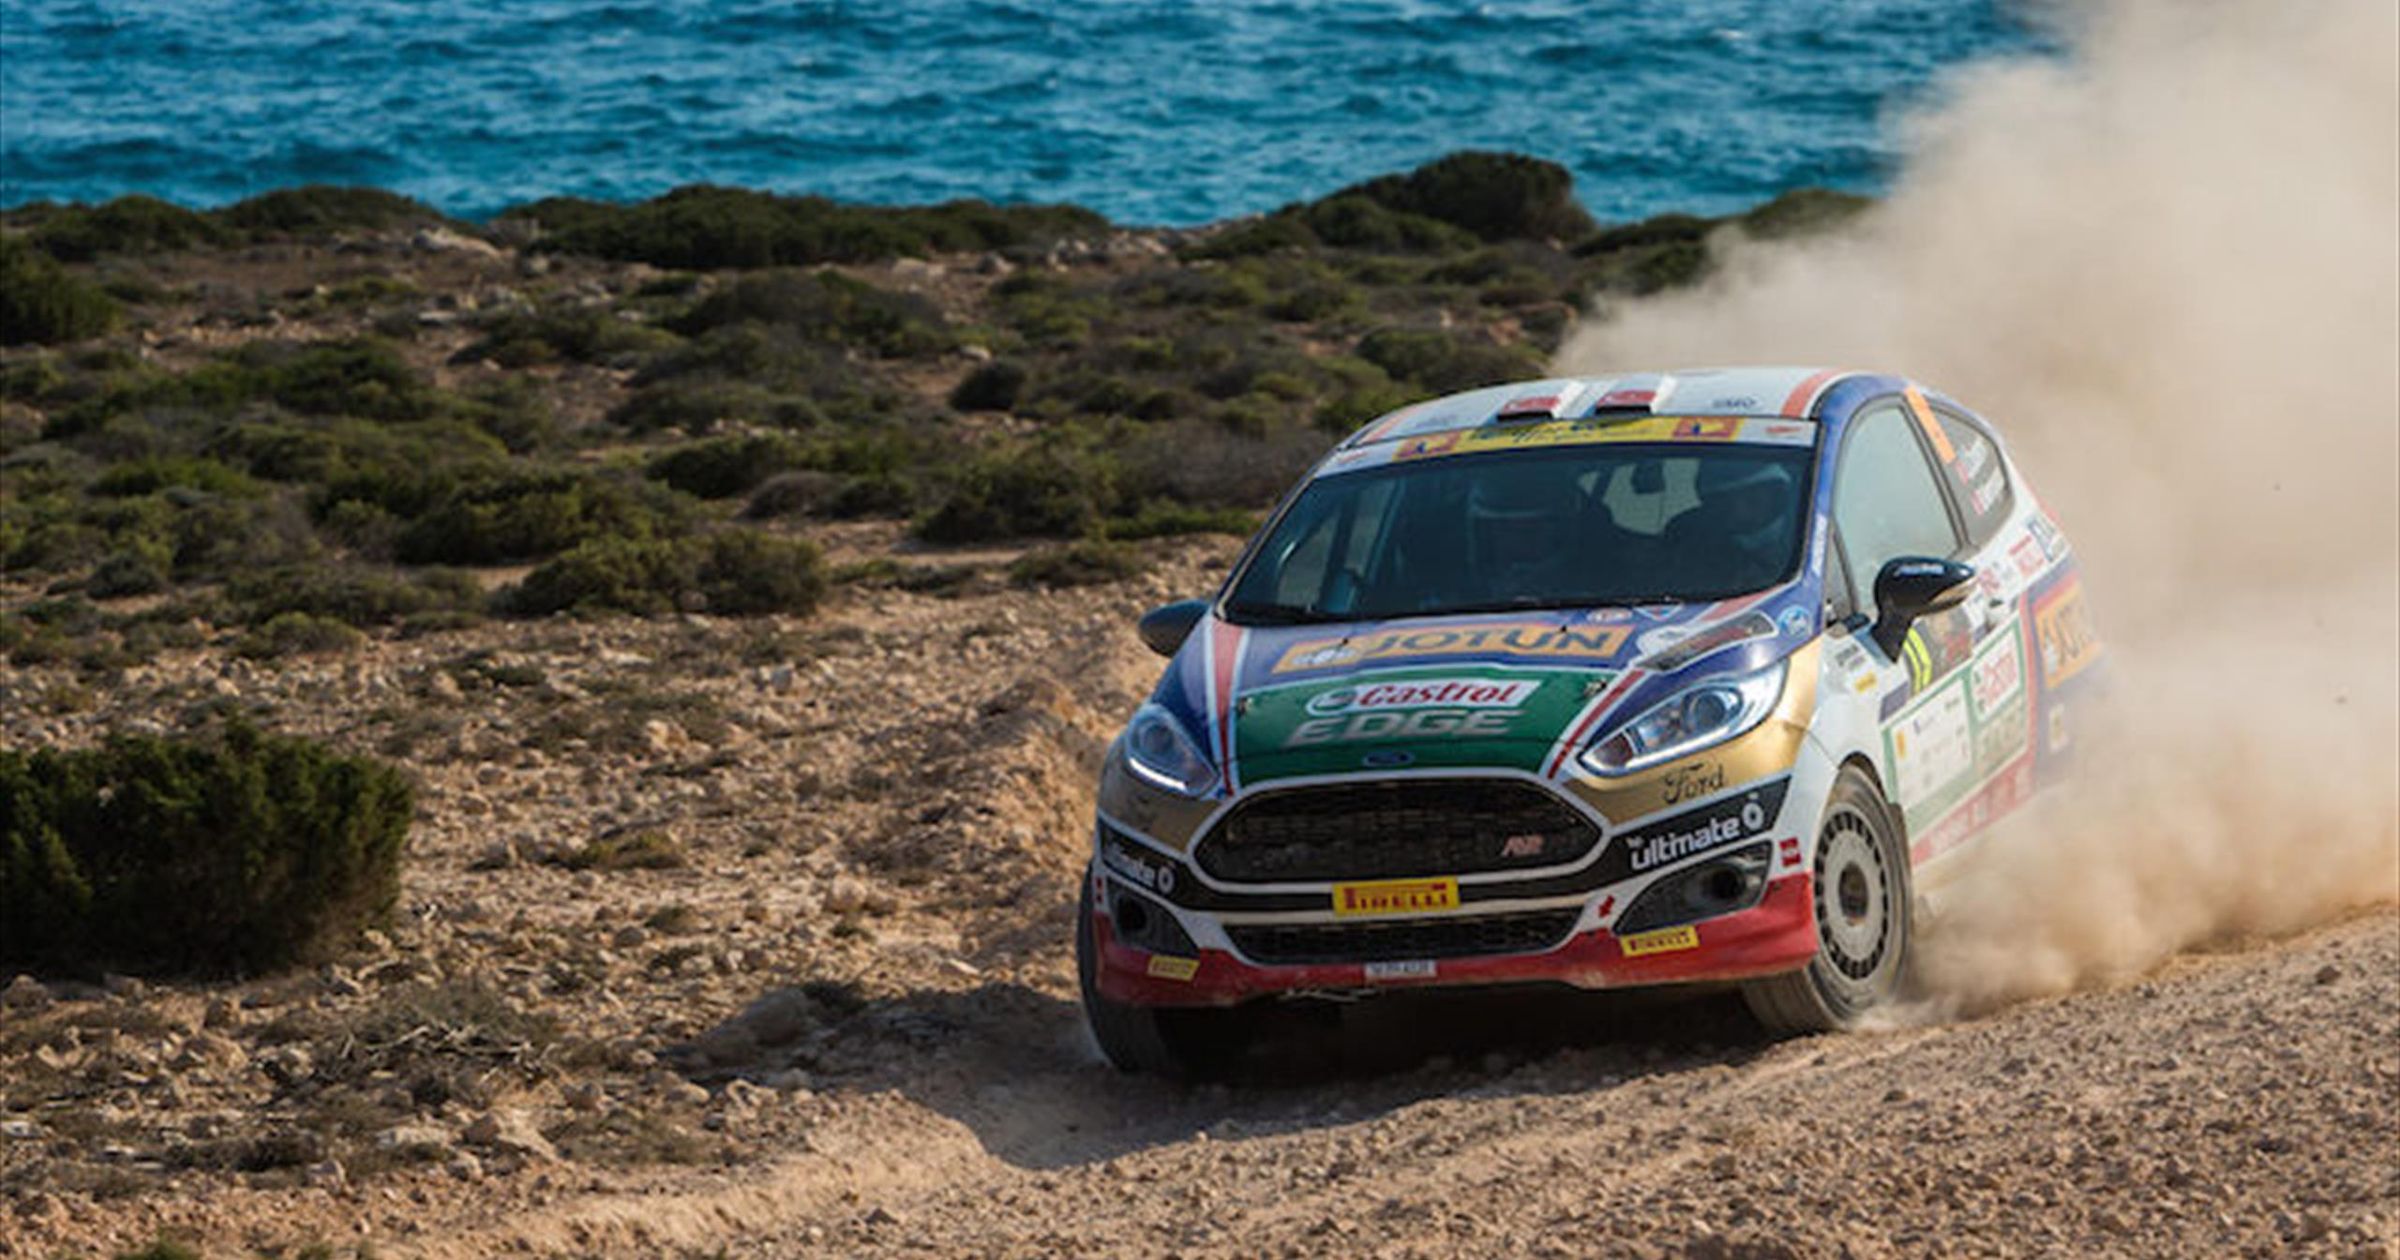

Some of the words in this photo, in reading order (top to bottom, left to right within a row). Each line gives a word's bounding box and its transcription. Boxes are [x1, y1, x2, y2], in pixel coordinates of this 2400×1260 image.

[1365, 627, 1606, 652] JOTUN
[1360, 681, 1518, 707] Castrol
[1283, 708, 1525, 747] EDGE
[1660, 762, 1724, 805] Ford
[1631, 817, 1740, 870] ultimate
[1343, 882, 1448, 910] PIRELLI
